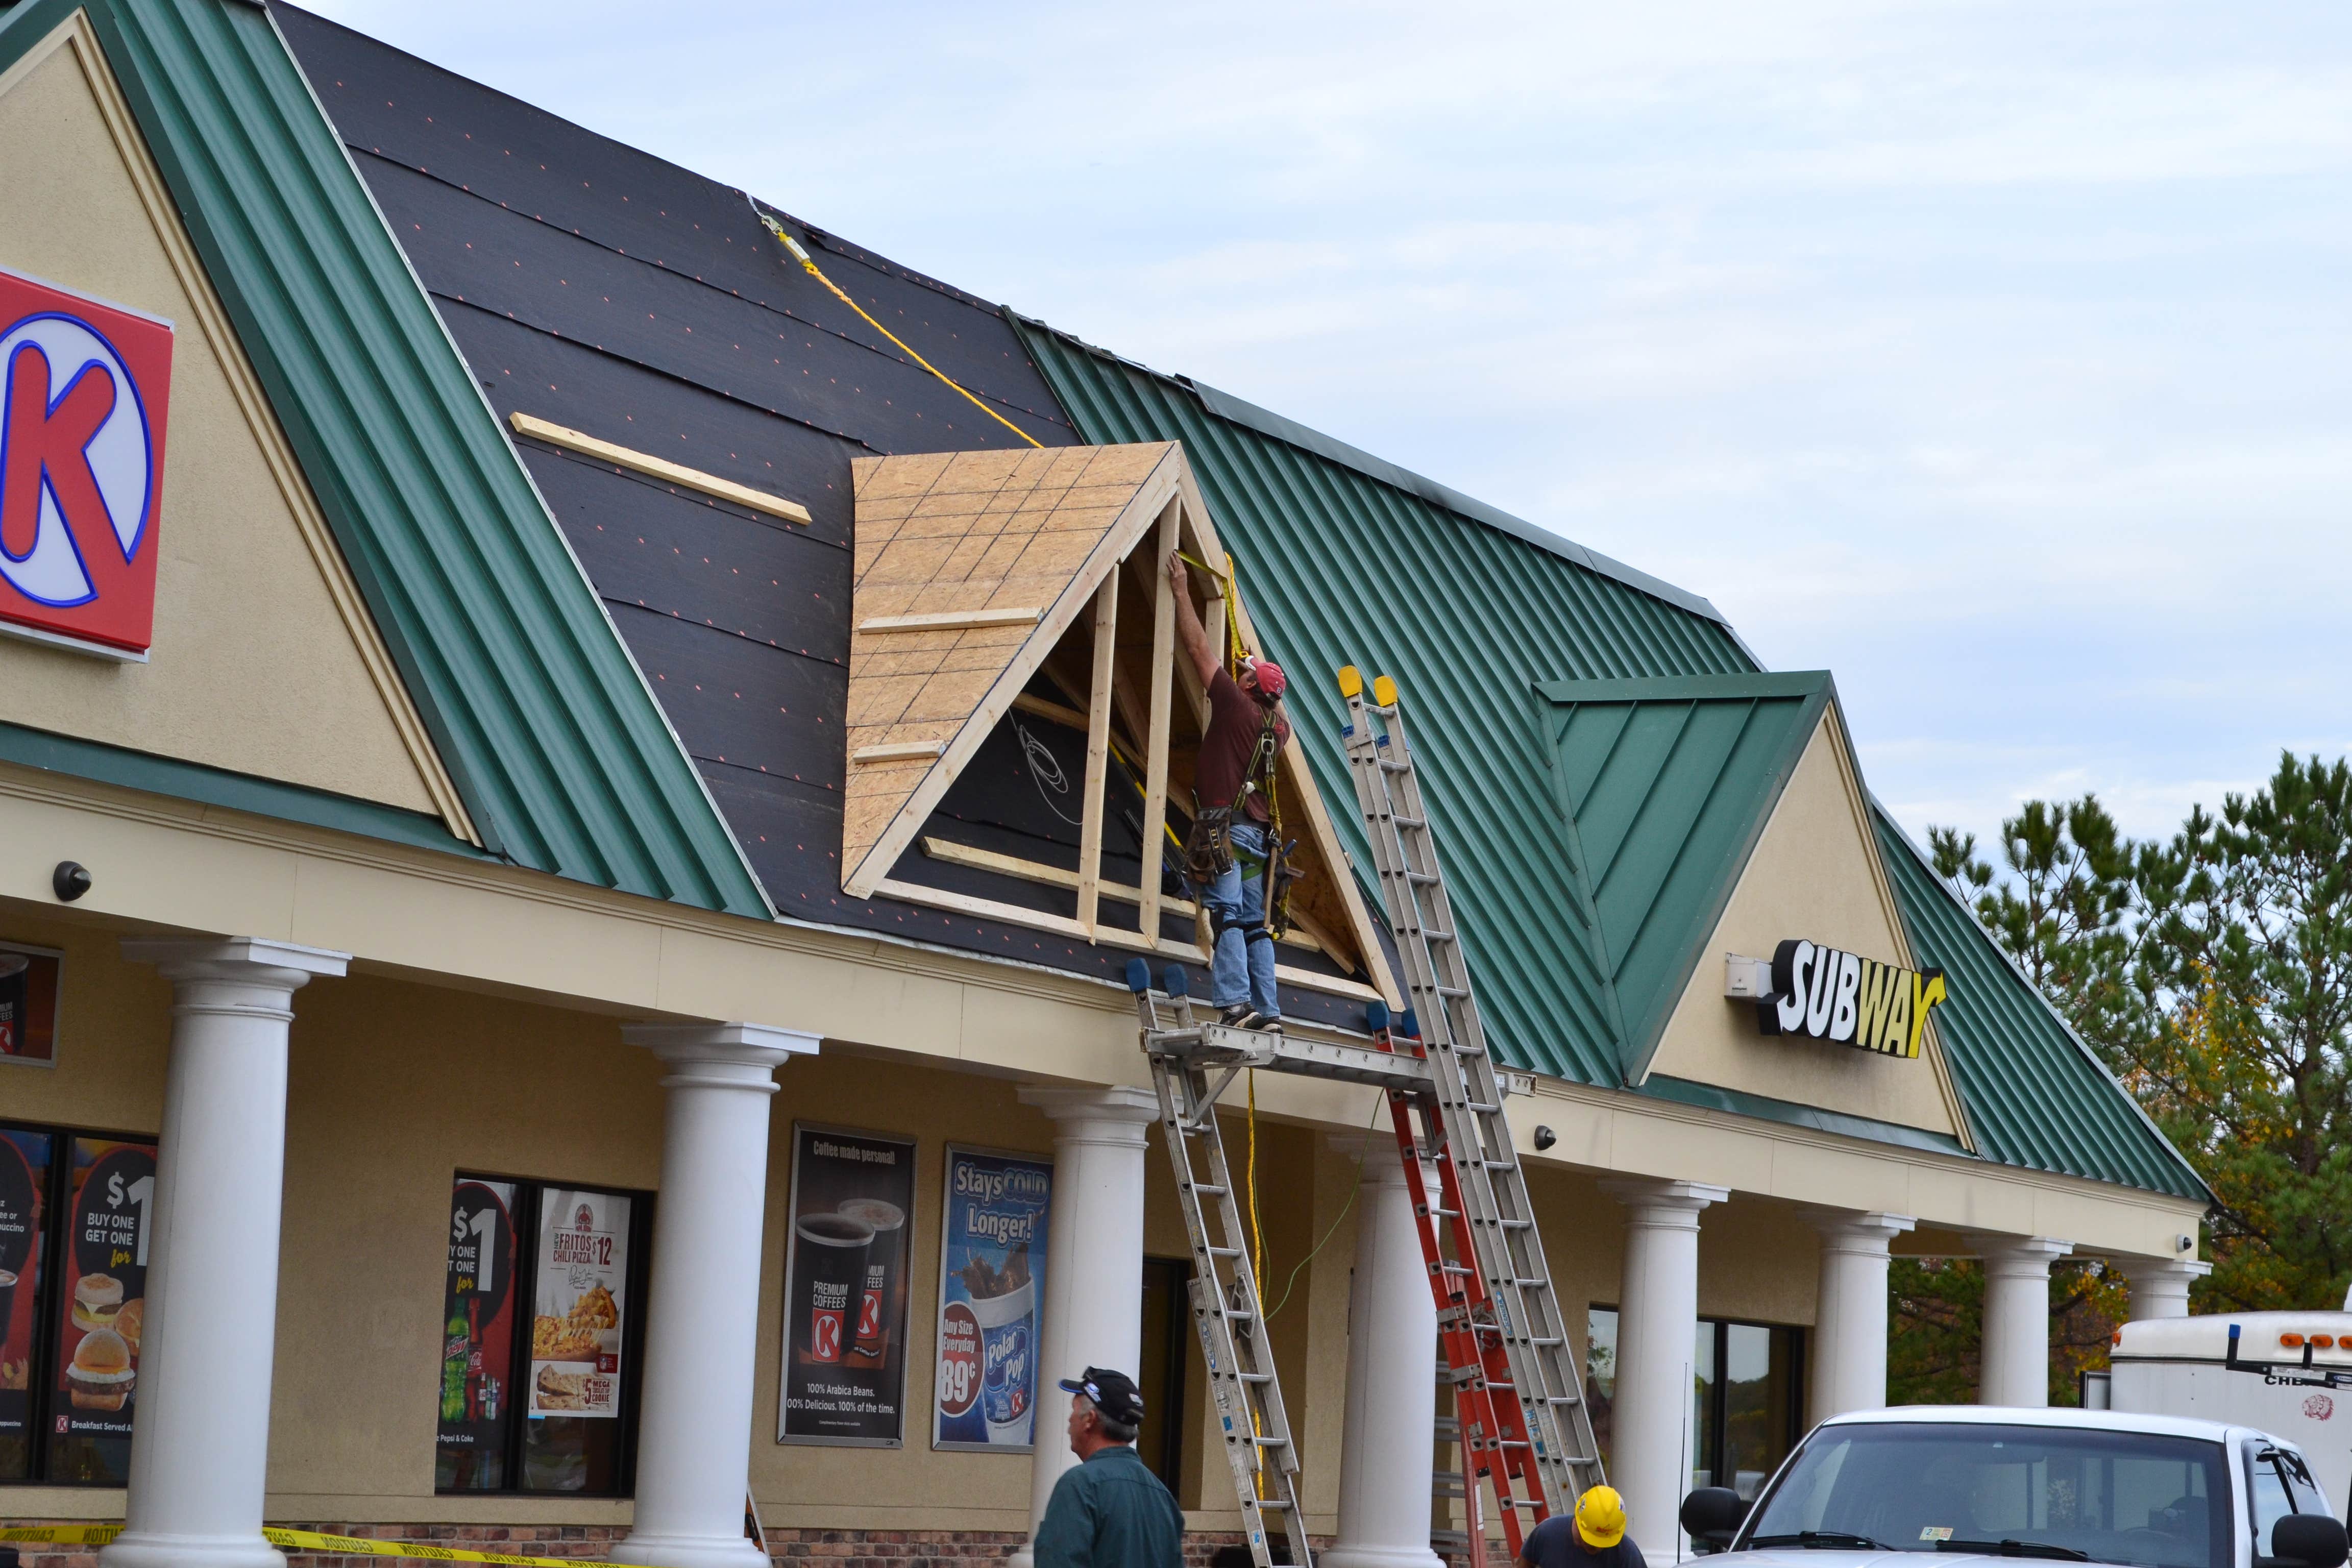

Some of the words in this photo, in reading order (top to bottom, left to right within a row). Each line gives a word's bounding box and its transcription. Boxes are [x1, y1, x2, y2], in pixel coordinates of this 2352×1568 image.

[2, 339, 130, 598] K
[1777, 940, 1947, 1059] SUBWAY
[814, 1140, 838, 1157] Coffee
[840, 1146, 860, 1160] made
[957, 1165, 1002, 1202] Stays
[1003, 1171, 1047, 1199] COLD
[88, 1213, 110, 1226] BUY
[112, 1215, 134, 1229] ONE
[107, 1172, 155, 1266] $1
[968, 1208, 1033, 1244] Longer!
[0, 1223, 24, 1232] uccino
[86, 1229, 107, 1242] GET
[110, 1232, 133, 1245] ONE
[559, 1233, 592, 1252] FRITOS
[453, 1206, 497, 1291] $1
[457, 1246, 476, 1258] ONE
[110, 1249, 131, 1268] for
[553, 1250, 570, 1263] CHILI
[572, 1252, 592, 1264] PIZZA
[456, 1261, 475, 1272] ONE
[456, 1276, 474, 1294] for
[814, 1281, 848, 1295] PREMIUM
[813, 1294, 846, 1308] COFFEES
[944, 1319, 958, 1335] Any
[958, 1319, 973, 1335] Size
[943, 1336, 975, 1354] Everyday
[989, 1331, 1017, 1369] Polar
[807, 1383, 825, 1393] 100%
[826, 1385, 851, 1395] Arabica
[853, 1386, 875, 1396] Beans.
[805, 1399, 837, 1411] Delicious.
[839, 1402, 856, 1412] 100%
[857, 1402, 865, 1412] of
[866, 1403, 876, 1413] the
[878, 1404, 895, 1414] time.
[71, 1420, 103, 1430] Breakfast
[104, 1423, 126, 1431] Served
[440, 1434, 455, 1443] Pepsi
